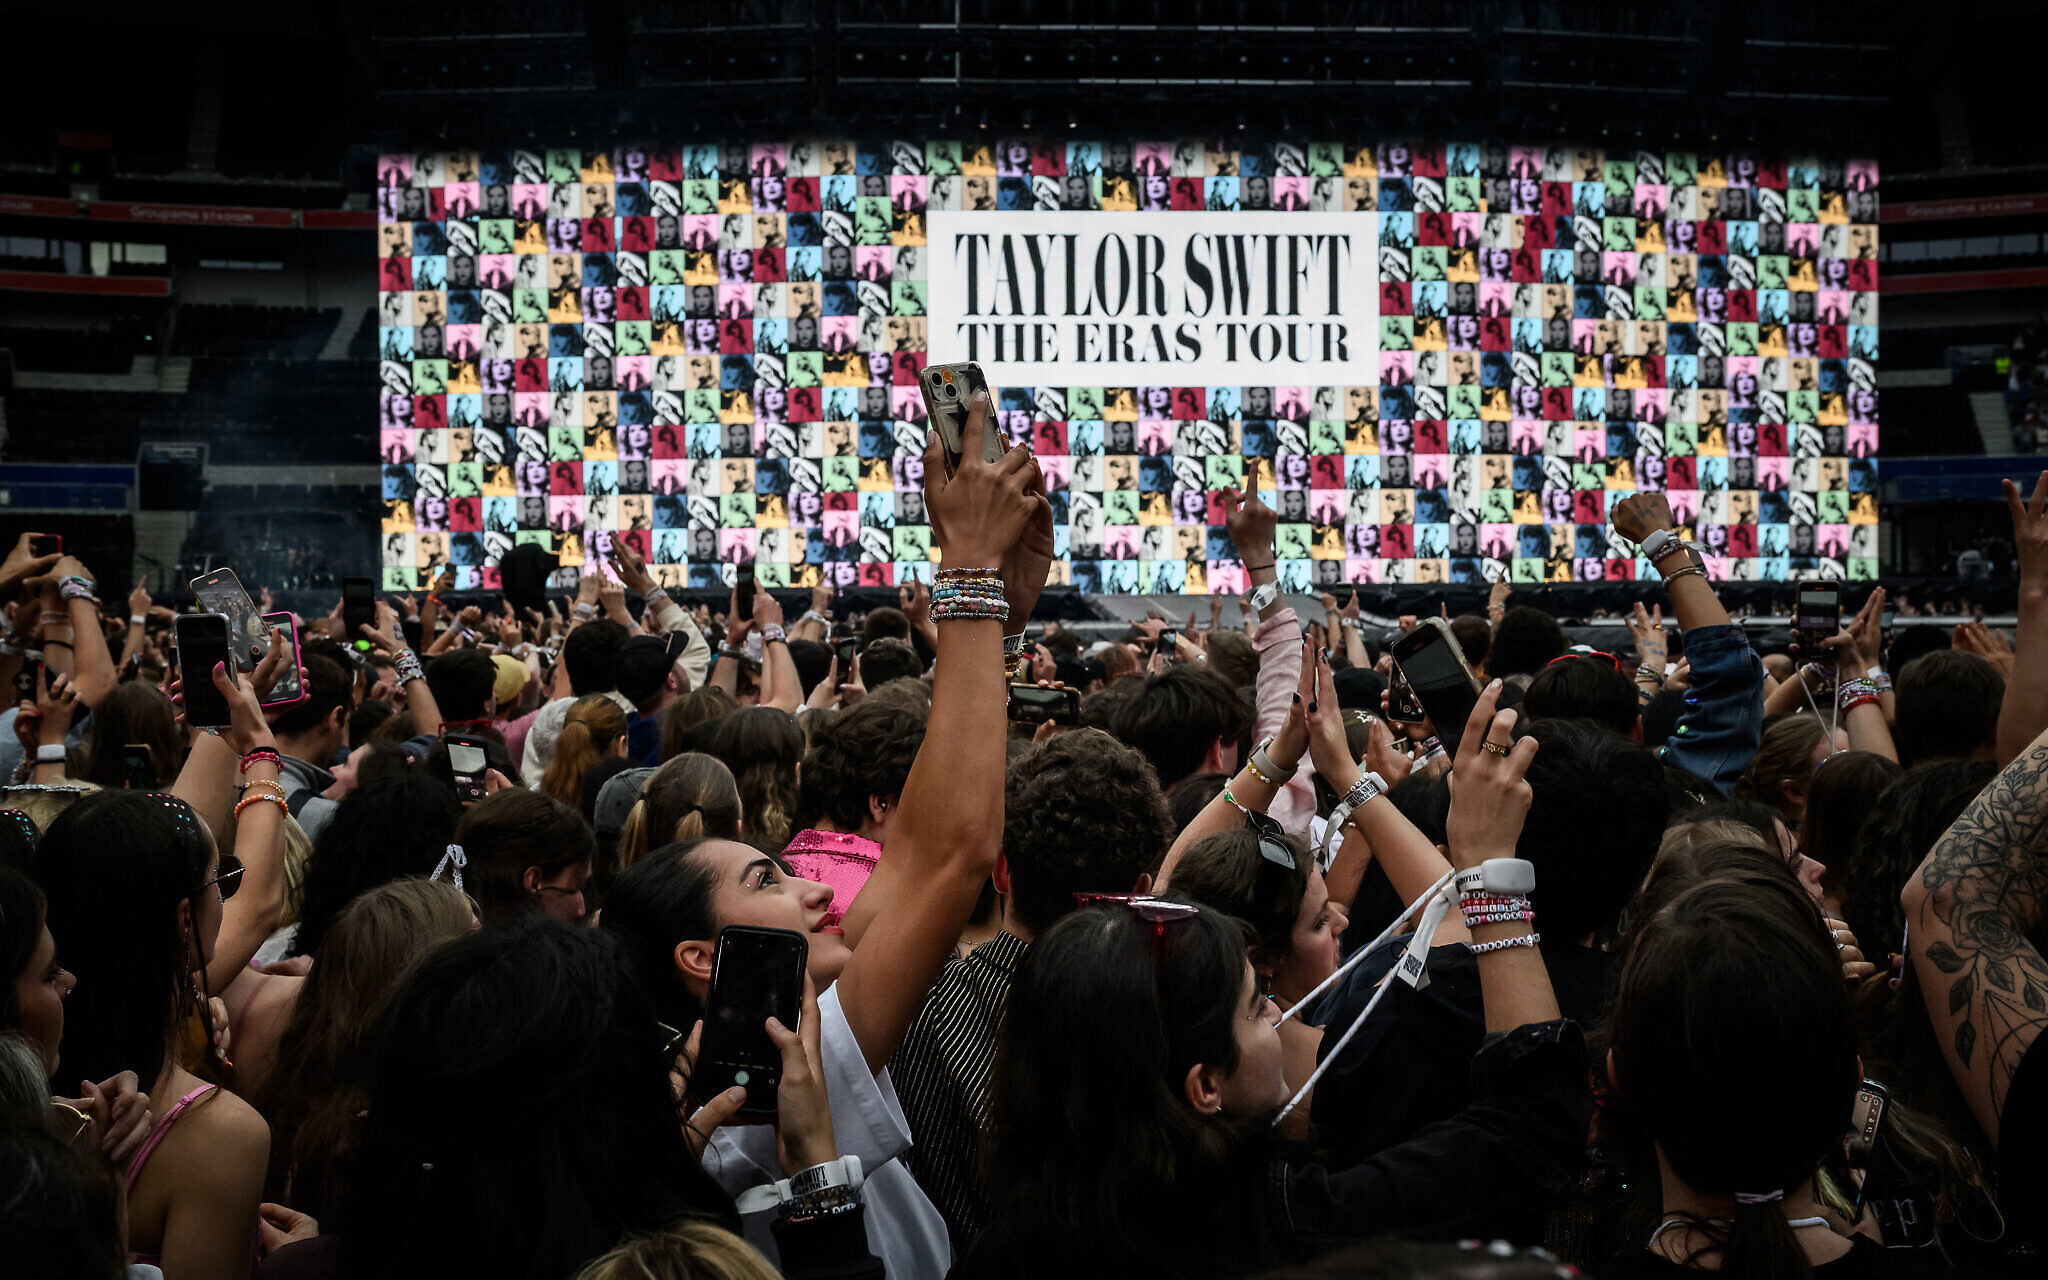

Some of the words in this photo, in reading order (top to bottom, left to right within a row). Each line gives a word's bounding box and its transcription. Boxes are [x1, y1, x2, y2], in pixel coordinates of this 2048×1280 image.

[955, 232, 1169, 318] TAYLOR
[1183, 232, 1352, 318] SWIFT
[957, 323, 1060, 363] THE
[1075, 323, 1203, 363] ERAS
[1216, 323, 1351, 363] TOUR
